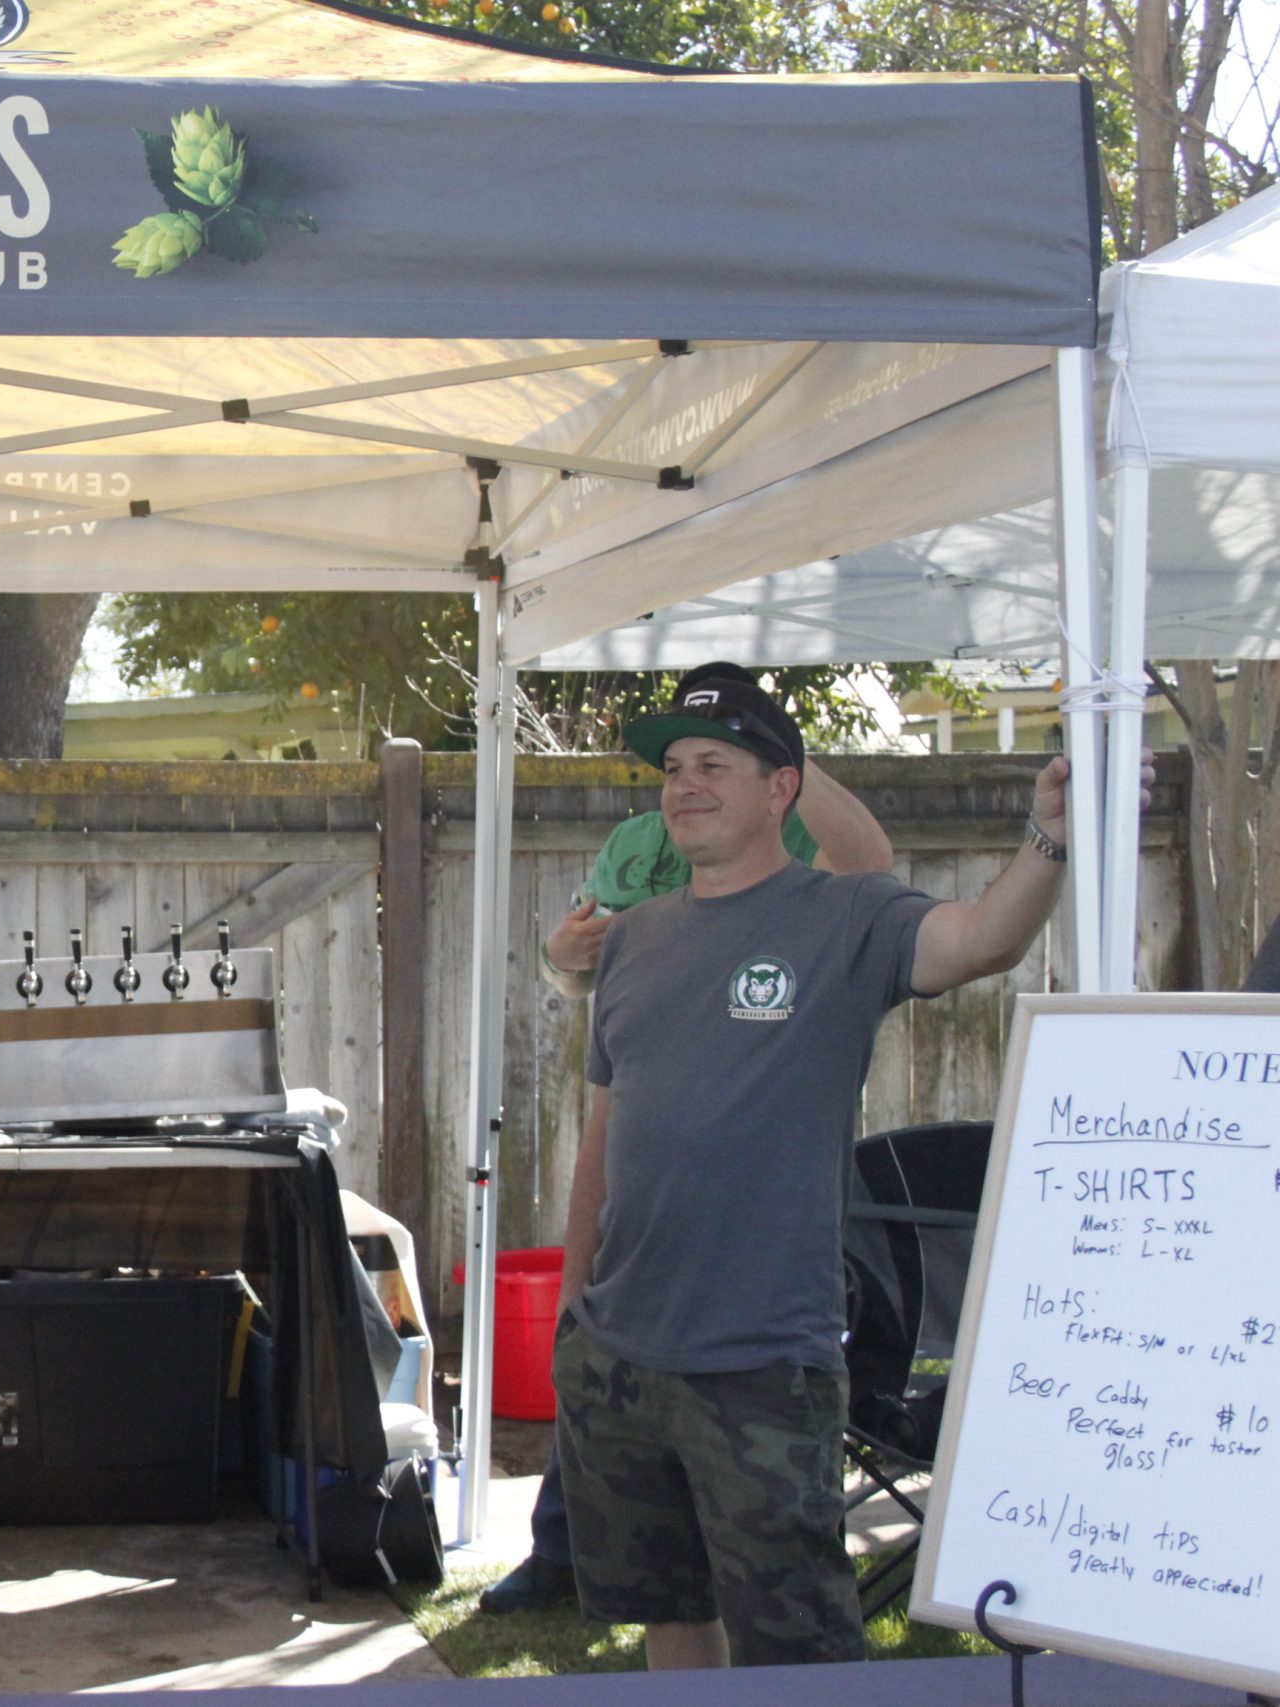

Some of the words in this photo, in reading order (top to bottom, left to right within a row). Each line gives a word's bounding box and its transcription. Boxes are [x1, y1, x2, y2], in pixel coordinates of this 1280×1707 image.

[1050, 1094, 1243, 1142] Merchandise
[1239, 1316, 1280, 1345] $2
[1177, 1344, 1195, 1356] or
[1008, 1362, 1072, 1399] Beer
[1165, 1431, 1194, 1450] for
[1068, 1549, 1136, 1581] greatly
[1152, 1567, 1264, 1599] appreciated!
